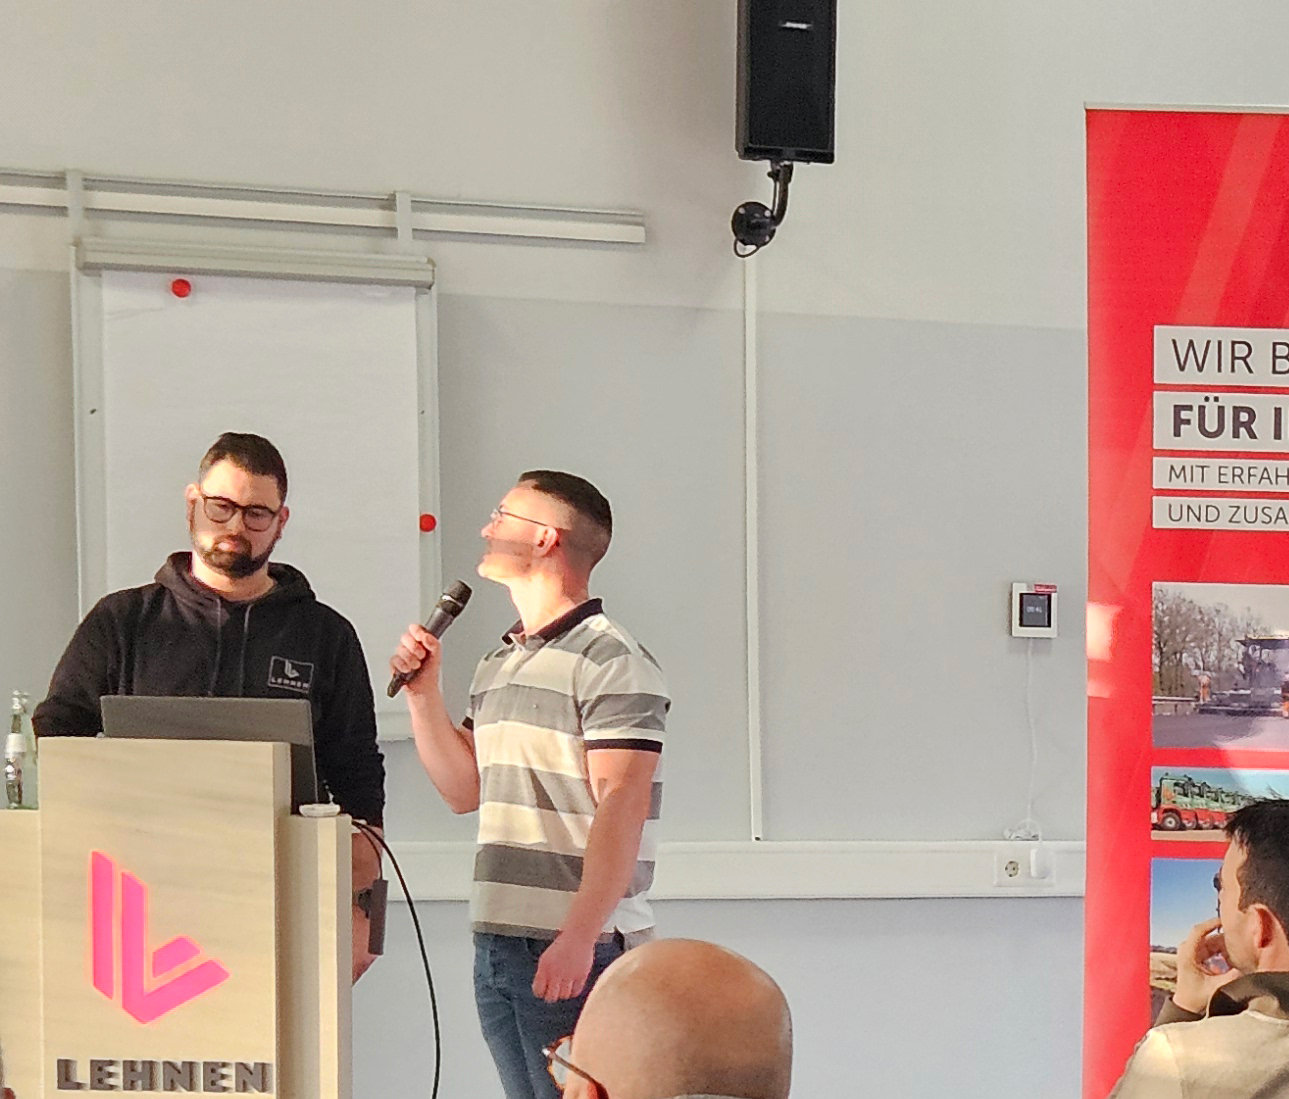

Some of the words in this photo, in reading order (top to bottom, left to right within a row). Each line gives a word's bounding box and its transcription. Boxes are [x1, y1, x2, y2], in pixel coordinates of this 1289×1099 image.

[1171, 338, 1254, 374] WIR
[1172, 396, 1258, 440] FÜR
[1168, 464, 1210, 484] MIT
[1168, 503, 1221, 523] UND
[57, 1058, 272, 1094] LEHNEN
